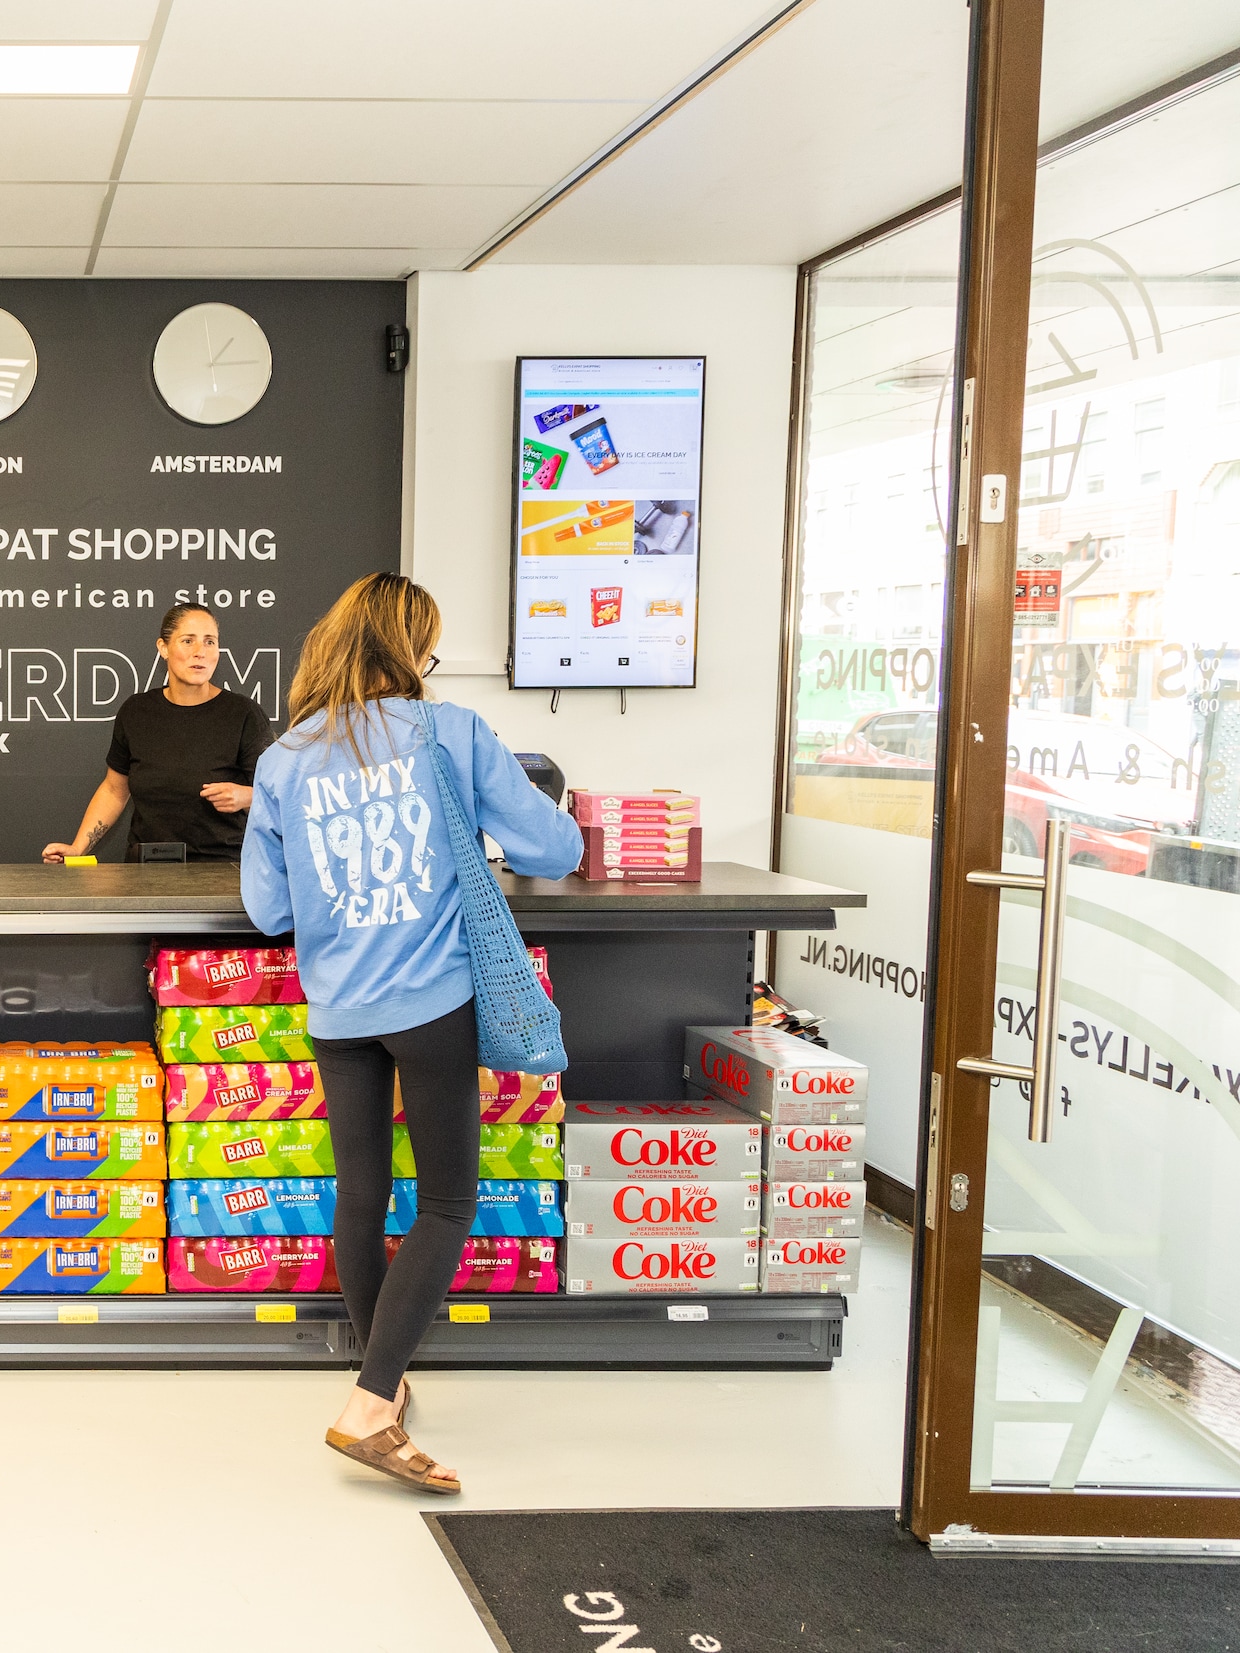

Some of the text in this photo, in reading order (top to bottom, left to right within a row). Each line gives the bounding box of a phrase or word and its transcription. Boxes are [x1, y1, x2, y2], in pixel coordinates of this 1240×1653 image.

[150, 456, 282, 474] AMSTERDAM
[67, 528, 277, 561] SHOPPING
[174, 586, 276, 609] store
[306, 756, 417, 816] IN MY
[306, 792, 432, 898] 1989
[346, 882, 422, 928] ERA
[209, 960, 246, 983] BARR
[255, 965, 297, 973] CHERRYAD
[217, 1022, 254, 1047] BARR
[269, 1028, 303, 1037] LIMEADE
[701, 1042, 750, 1097] Coke
[294, 1088, 315, 1096] SODA
[792, 1070, 855, 1094] Coke
[116, 1093, 138, 1103] 100%
[219, 1085, 257, 1106] BARR
[680, 1127, 708, 1139] Diet
[748, 1128, 759, 1136] 18
[787, 1128, 852, 1152] Coke
[225, 1138, 263, 1162] BARR
[278, 1143, 312, 1152] LIMEADE
[610, 1127, 717, 1166] Coke
[276, 1193, 320, 1202] LEMONADE
[682, 1183, 709, 1196] Diet
[748, 1184, 759, 1192] 18
[788, 1184, 852, 1209] Coke
[228, 1187, 266, 1212] BARR
[613, 1185, 717, 1224] Coke
[681, 1240, 708, 1252] Diet
[746, 1240, 757, 1248] 18
[781, 1240, 846, 1265] Coke
[120, 1252, 143, 1262] 100%
[224, 1249, 263, 1270] BARR
[271, 1252, 319, 1261] CHERRYADE
[465, 1258, 512, 1266] CHERRYADE
[612, 1242, 716, 1280] Coke
